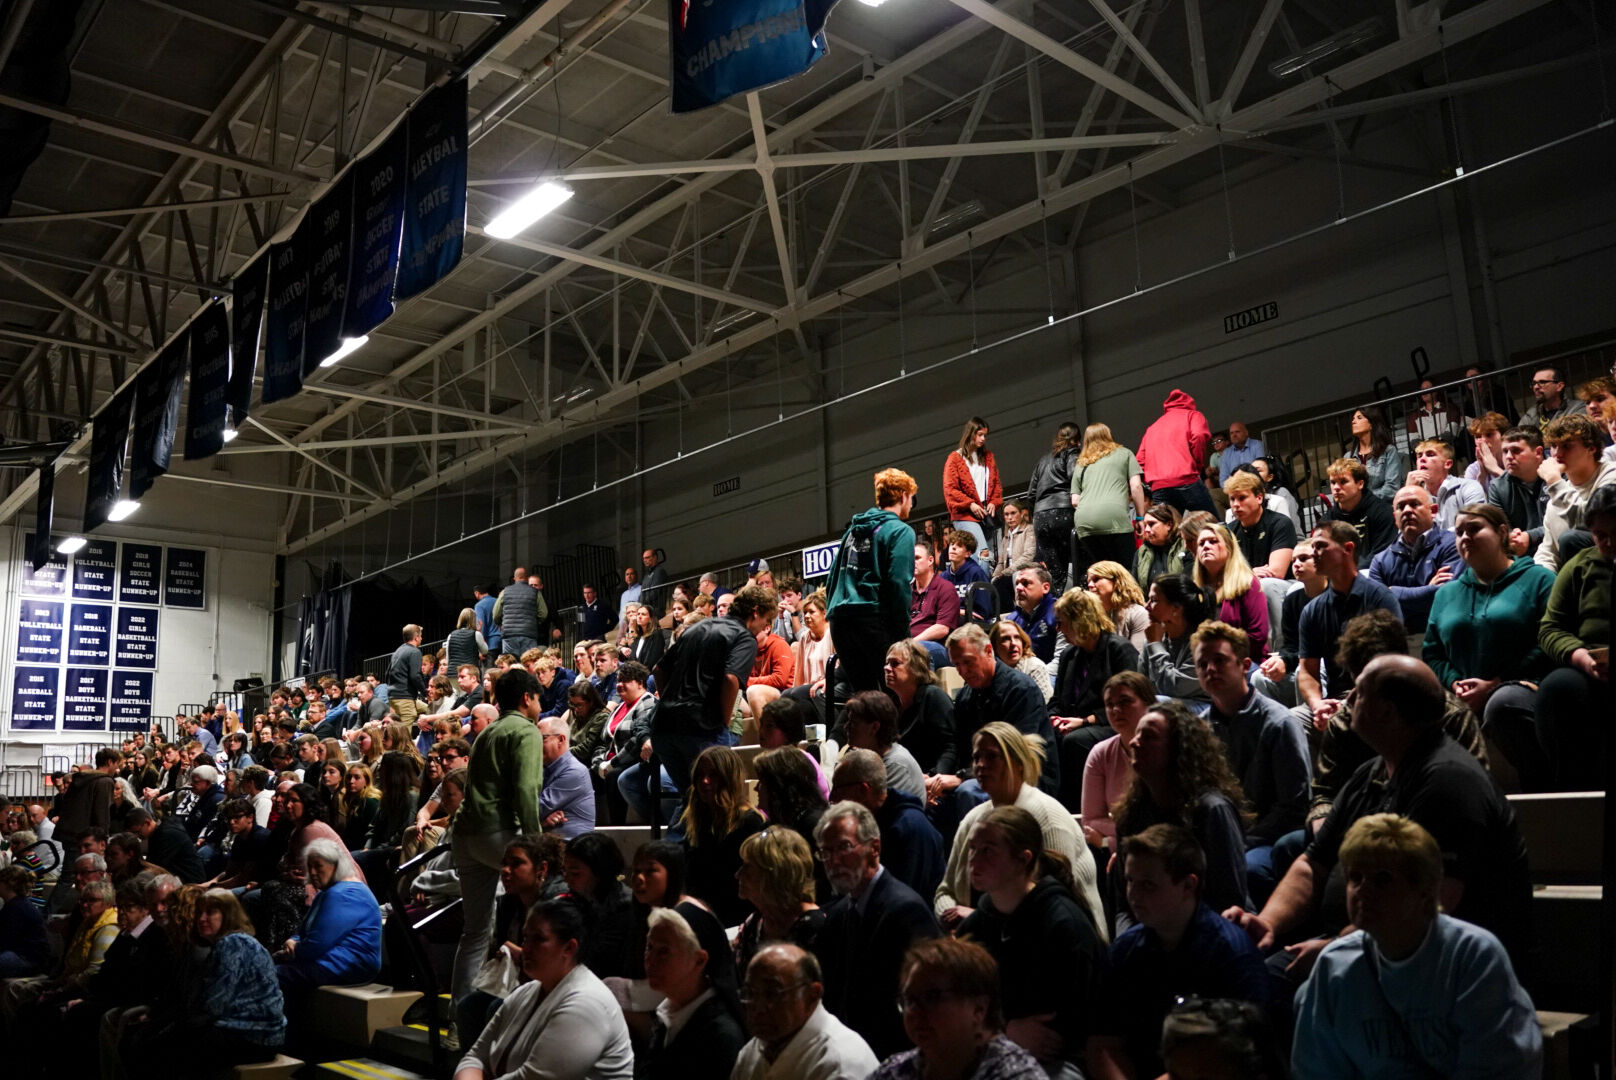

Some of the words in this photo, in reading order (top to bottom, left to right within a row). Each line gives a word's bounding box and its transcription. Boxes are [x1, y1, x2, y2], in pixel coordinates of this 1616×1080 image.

[370, 166, 394, 197] 2020
[418, 185, 449, 219] STATE
[1225, 302, 1278, 332] HOME
[713, 477, 740, 496] HOME
[74, 559, 115, 568] VOLLEYBALL
[806, 546, 840, 574] HO
[84, 571, 104, 579] STATE
[170, 569, 200, 577] BASEBALL
[175, 578, 194, 586] STATE
[74, 583, 112, 592] RUNNER-UP
[122, 587, 158, 596] RUNNER-UP
[167, 586, 202, 595] RUNNER-UP
[19, 621, 63, 630] VOLLEYBALL
[73, 624, 106, 633] BASEBALL
[30, 634, 51, 642] STATE
[79, 637, 100, 645] STATE
[117, 633, 156, 642] BASKETBALL
[19, 646, 59, 655] RUNNER-UP
[69, 649, 108, 657] RUNNER-UP
[117, 652, 154, 660] RUNNER-UP
[18, 688, 53, 696] BASEBALL
[65, 695, 106, 703] BASKETBALL
[111, 697, 151, 706] BASKETBALL
[65, 714, 104, 722] RUNNER-UP
